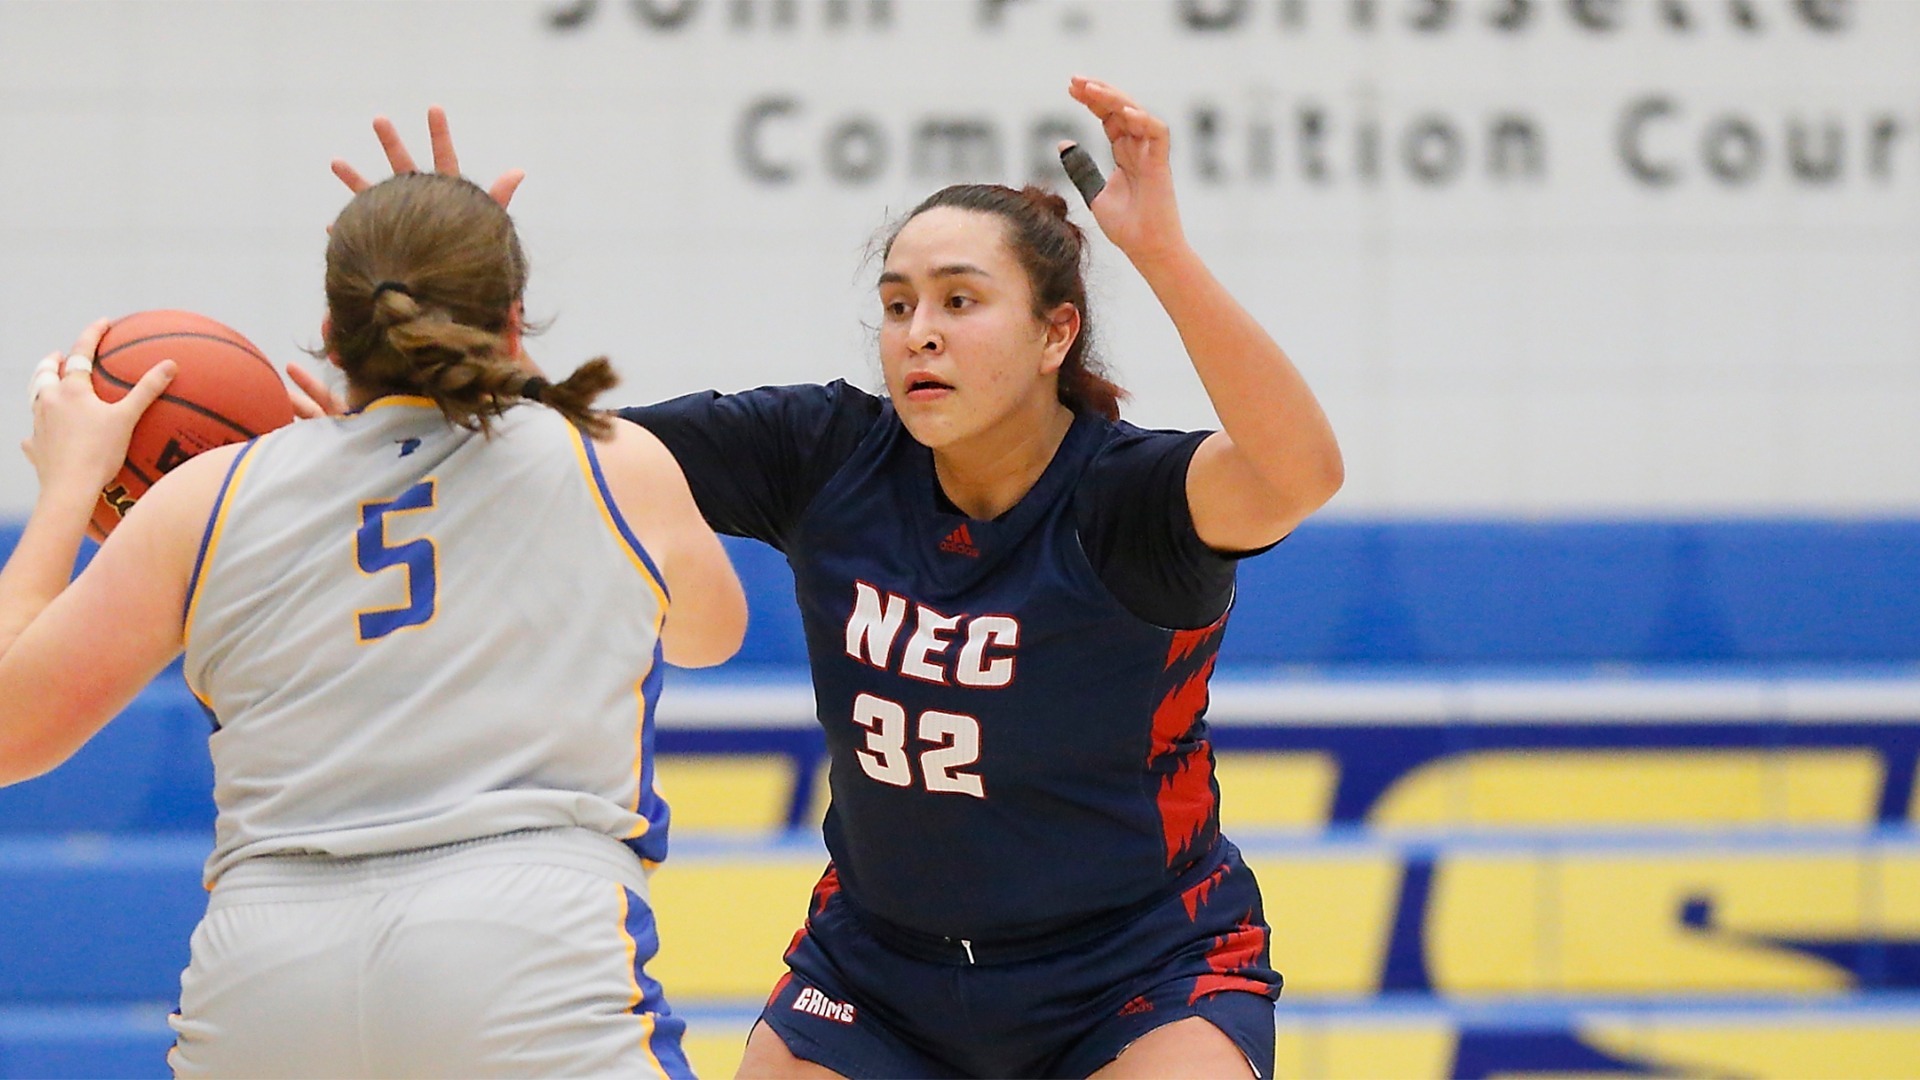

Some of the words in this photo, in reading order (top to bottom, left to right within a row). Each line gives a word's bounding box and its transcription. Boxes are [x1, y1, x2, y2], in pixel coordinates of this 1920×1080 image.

[735, 94, 1546, 190] Comptition
[353, 477, 438, 644] 5
[846, 580, 1019, 688] NEC
[853, 693, 985, 798] 32
[792, 986, 856, 1024] GRIMS
